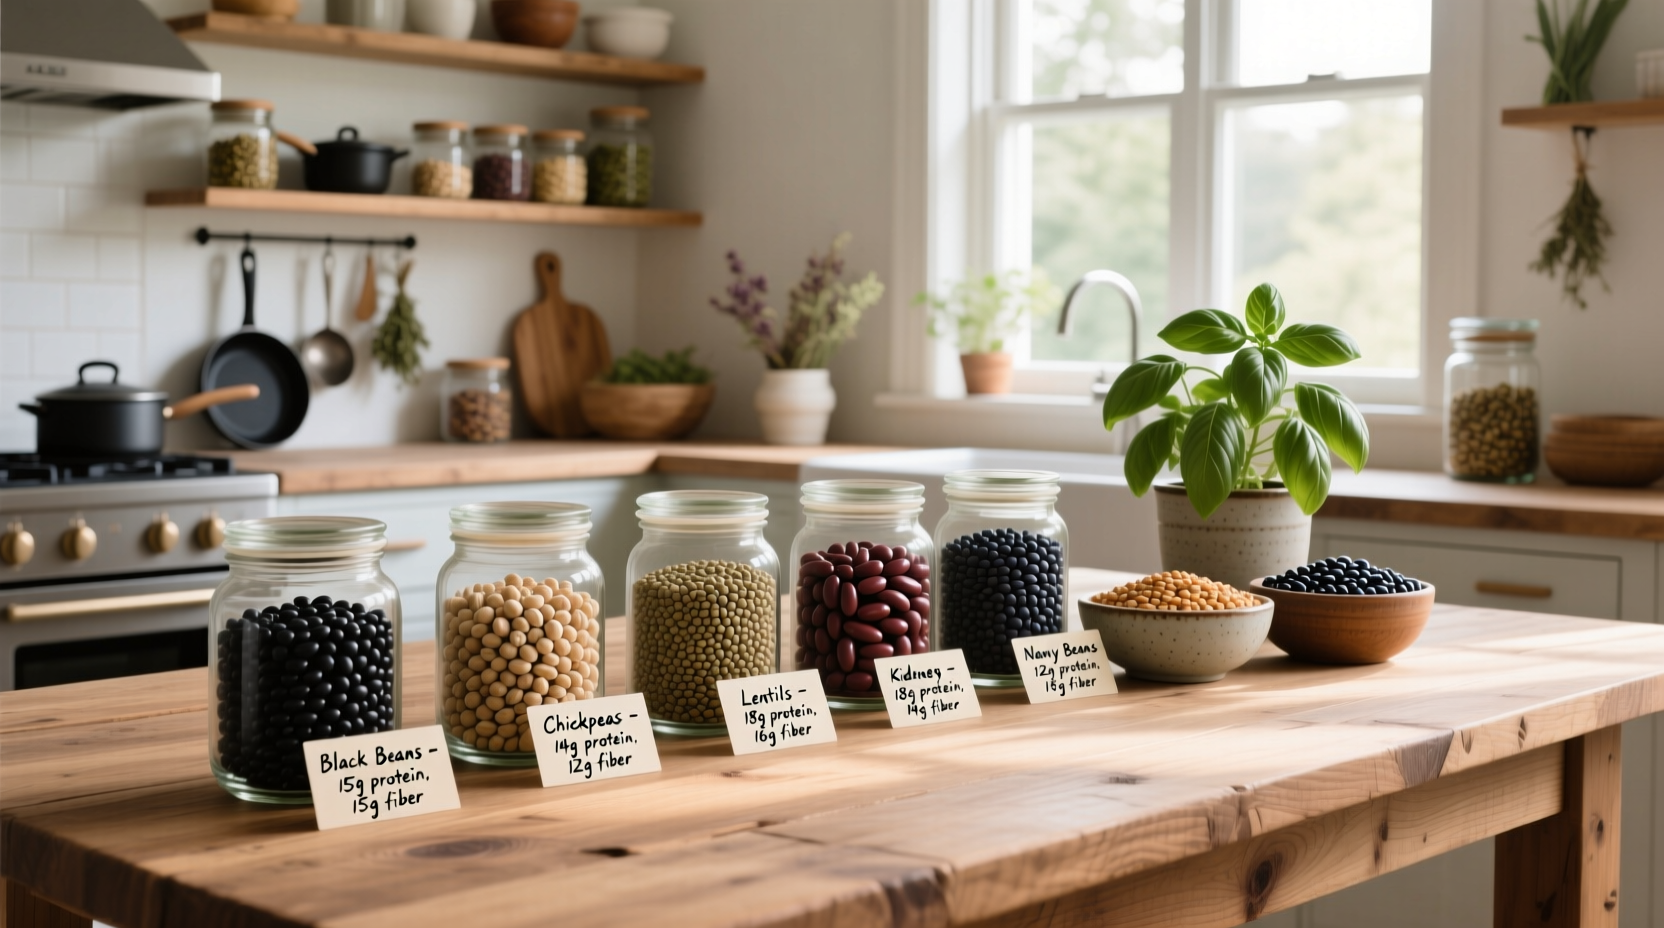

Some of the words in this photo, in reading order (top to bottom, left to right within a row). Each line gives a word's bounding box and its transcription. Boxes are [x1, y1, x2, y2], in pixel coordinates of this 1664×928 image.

[1062, 642, 1098, 657] Beans
[741, 684, 793, 706] Lentils
[895, 686, 916, 705] 18g
[744, 710, 766, 729] 18g
[907, 703, 927, 720] 14g
[543, 711, 623, 735] Chickpeas
[755, 729, 777, 747] 16g
[780, 721, 812, 741] fiber
[555, 738, 578, 758] 14g
[320, 750, 368, 774] Black
[375, 746, 423, 766] Beans
[569, 758, 592, 779] 12g
[597, 751, 632, 772] fiber
[339, 775, 364, 797] 15g
[353, 796, 379, 819] 15g
[384, 788, 424, 811] fiber
